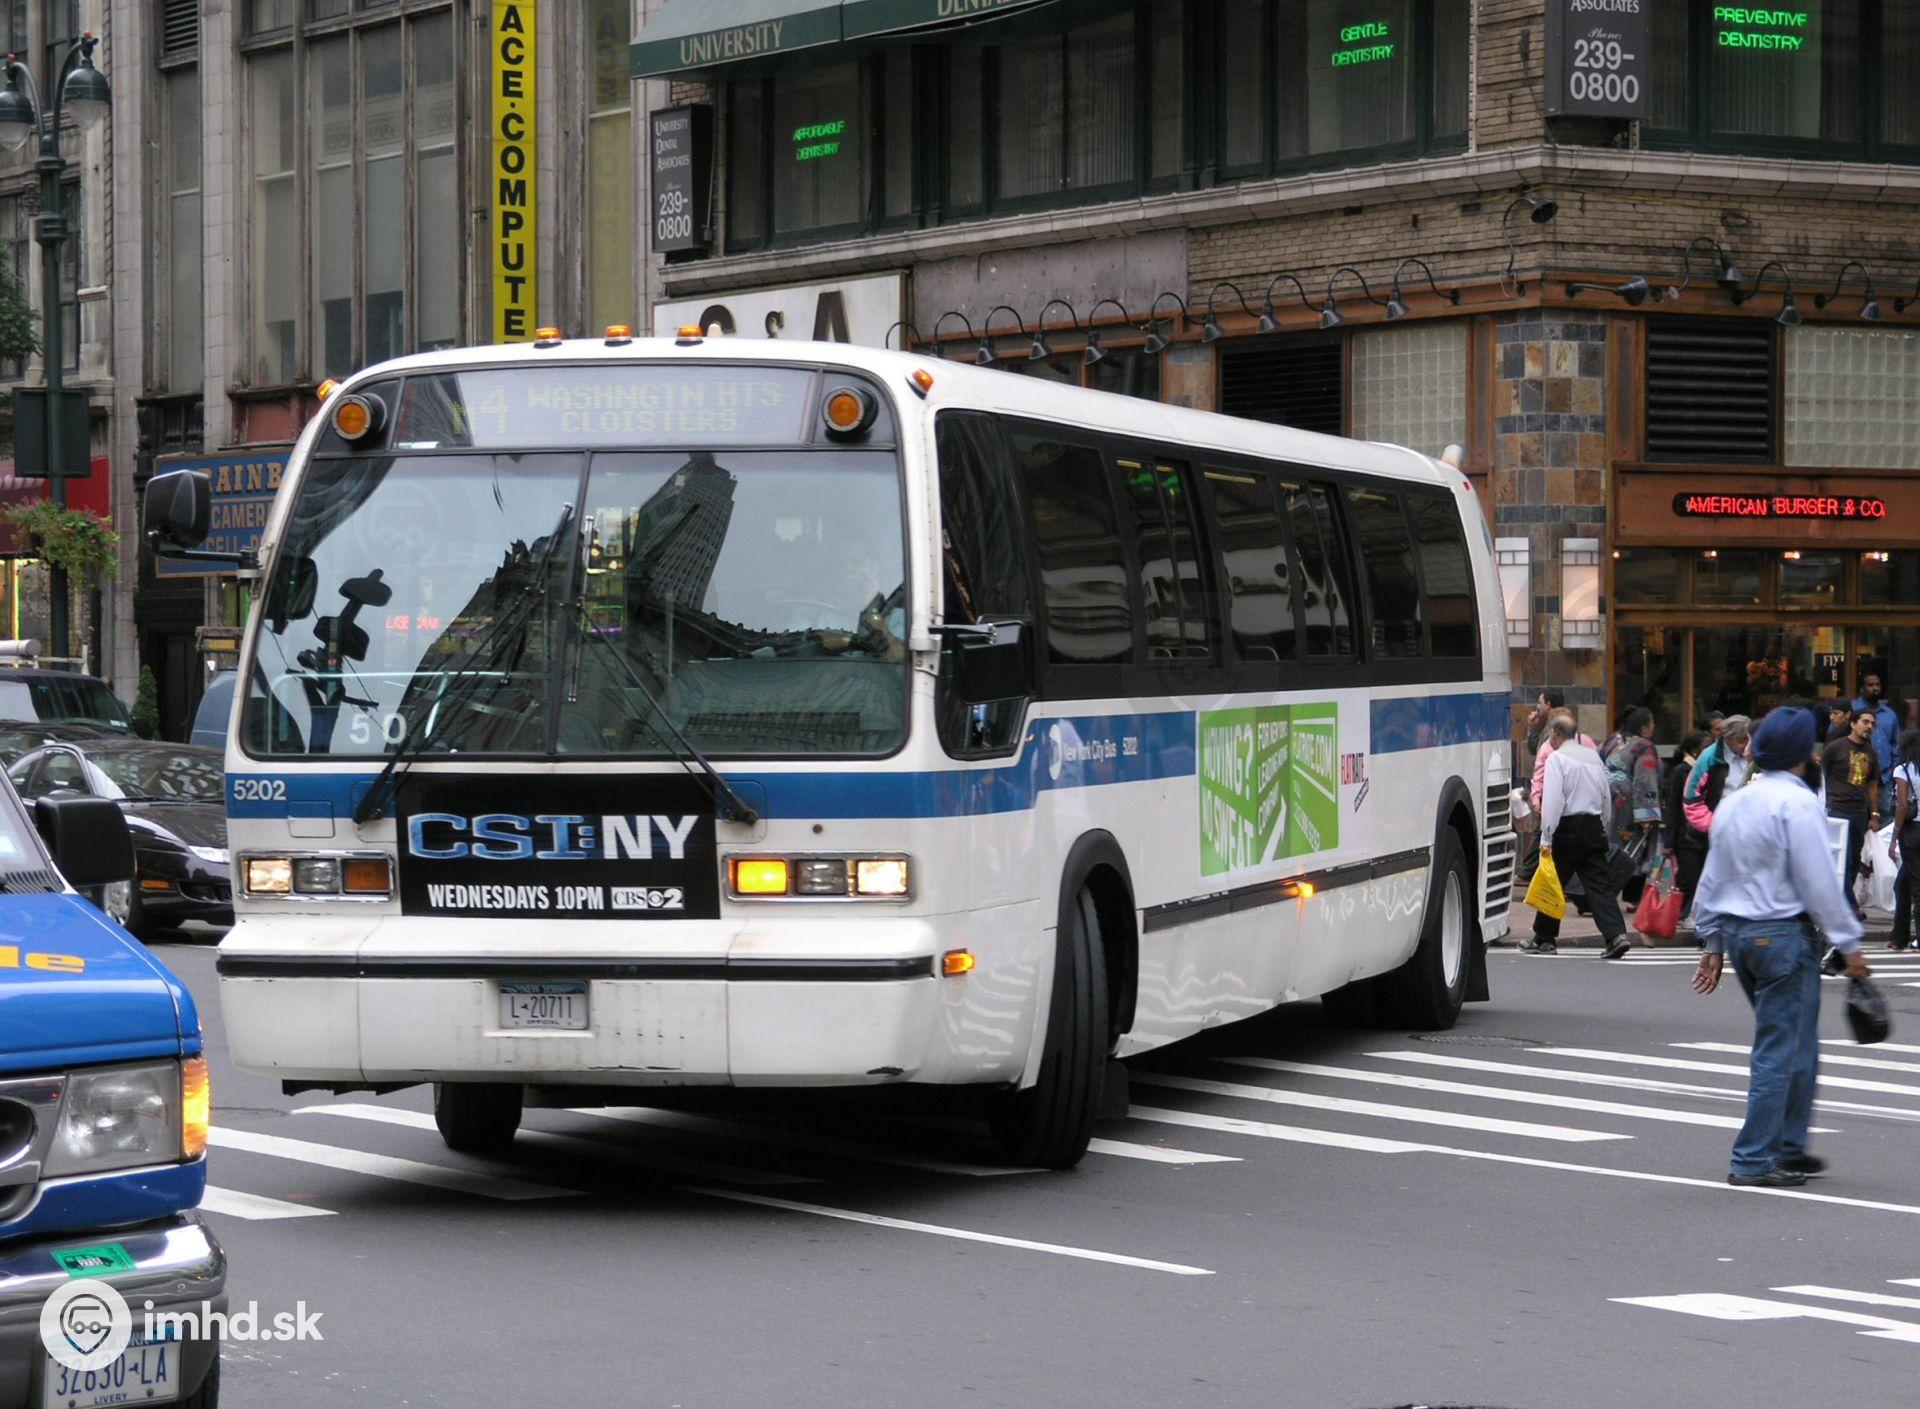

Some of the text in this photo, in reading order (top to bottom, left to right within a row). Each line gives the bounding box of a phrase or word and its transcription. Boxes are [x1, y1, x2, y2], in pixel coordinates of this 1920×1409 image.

[680, 22, 783, 65] UNIVERSITY
[1341, 22, 1388, 42] GENTLE
[1718, 31, 1803, 50] DENTISTRY
[1332, 44, 1394, 67] DENTISTRY
[1574, 39, 1635, 70] 239-
[1569, 71, 1639, 104] 0800
[659, 191, 688, 215] 239-
[499, 112, 527, 343] COMPUTE
[658, 215, 691, 240] 0800
[717, 382, 782, 408] HTS
[560, 410, 739, 433] CLOISTERS
[211, 504, 272, 529] CAMER
[1686, 496, 1768, 516] AMERICAN
[1774, 497, 1839, 516] BURGER
[1843, 499, 1855, 516] &
[233, 779, 287, 801] 5202
[427, 884, 683, 910] WEDNESDAYS 10PM CBS 2
[530, 995, 572, 1018] 20711
[141, 1346, 167, 1385] LA
[94, 1391, 128, 1406] LIVERY
